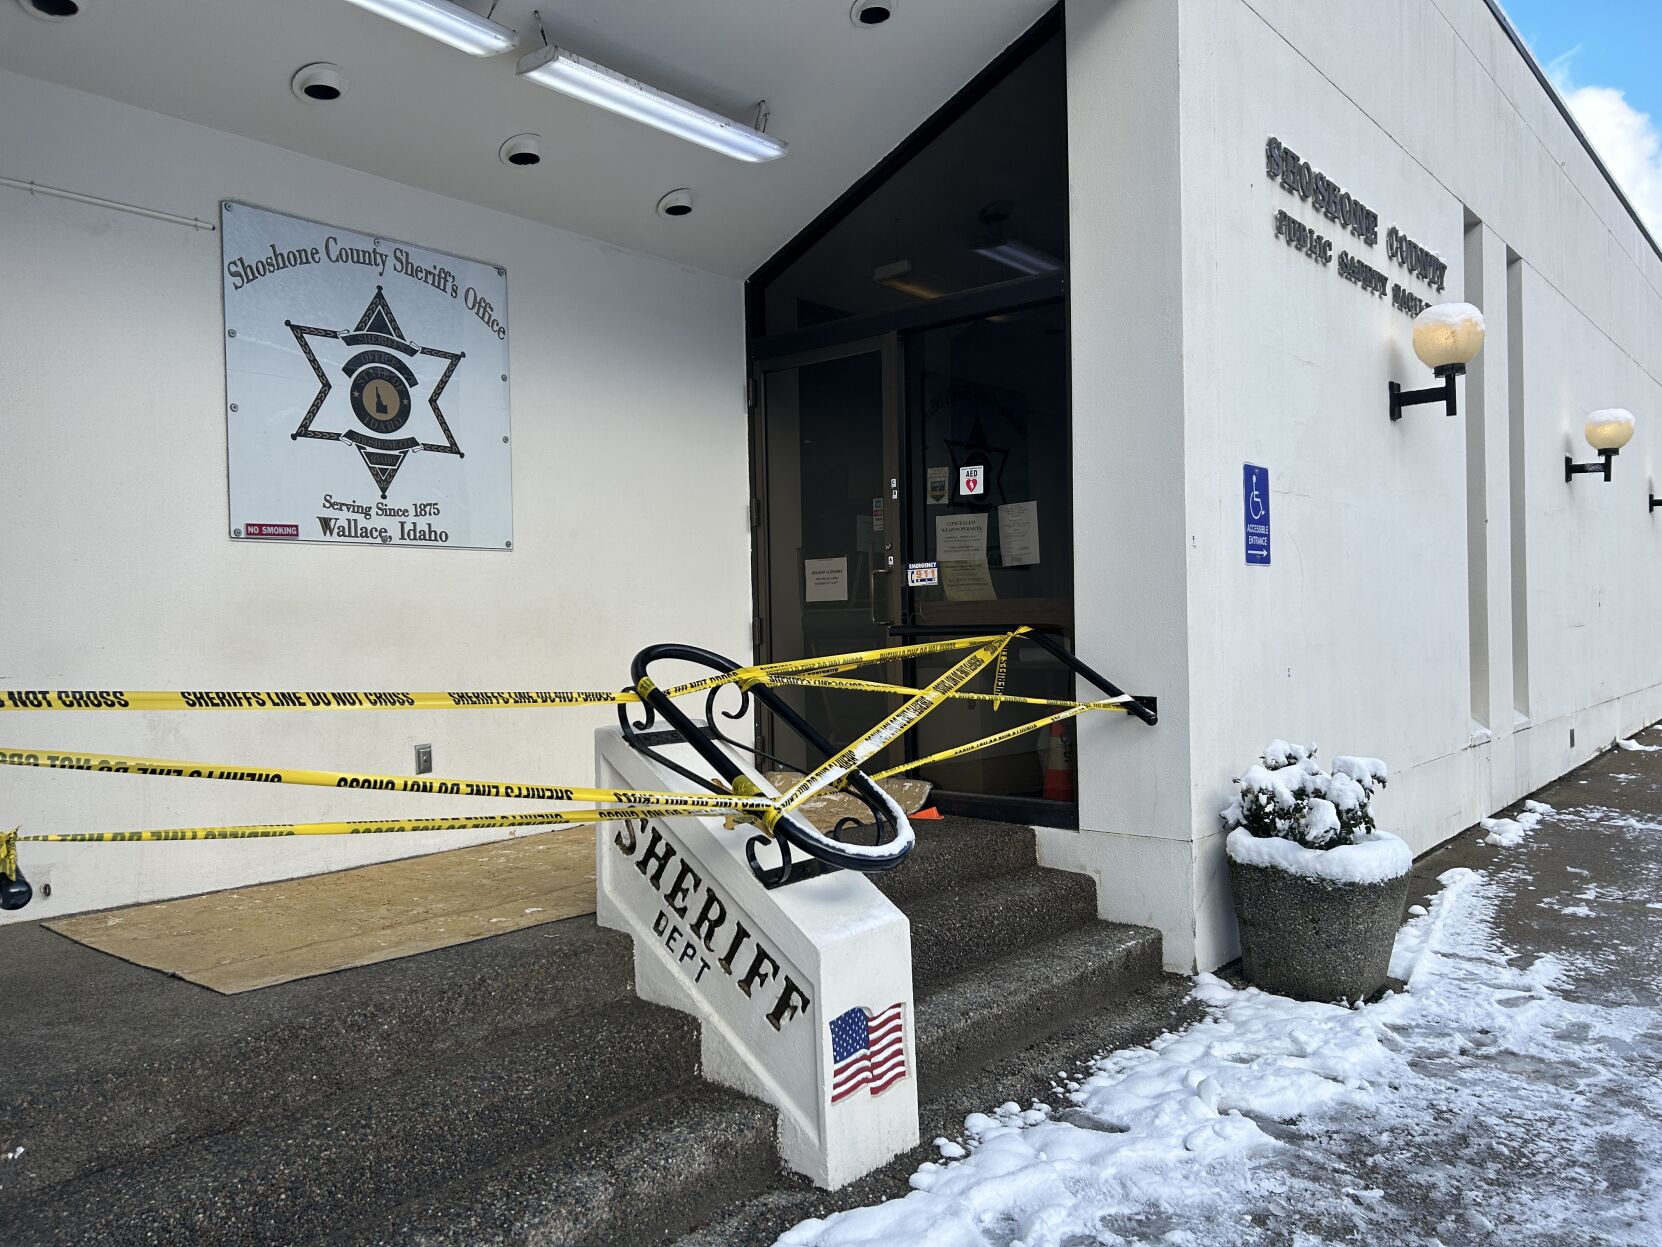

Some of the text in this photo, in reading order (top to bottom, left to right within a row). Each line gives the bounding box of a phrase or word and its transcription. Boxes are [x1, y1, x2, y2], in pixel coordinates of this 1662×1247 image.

[1266, 137, 1378, 247] SHOSHONE
[227, 236, 506, 340] Shoshone County Sheriff's Office
[965, 470, 978, 478] AED
[323, 494, 441, 519] Serving Since 1875
[247, 525, 297, 535] NO SMOKING
[316, 516, 449, 543] Wallace, Idaho
[1247, 523, 1269, 534] ACCESSIBLE
[1248, 535, 1267, 545] ENTRANCE
[915, 570, 936, 578] 911
[7, 691, 53, 708] NOT
[57, 691, 130, 708] CROSS
[181, 691, 415, 707] SHERIFFS LINE DO NOT CROSS
[447, 691, 510, 706] SHERIFFS
[614, 805, 811, 1032] SHERIFF
[652, 909, 711, 984] DEPT
